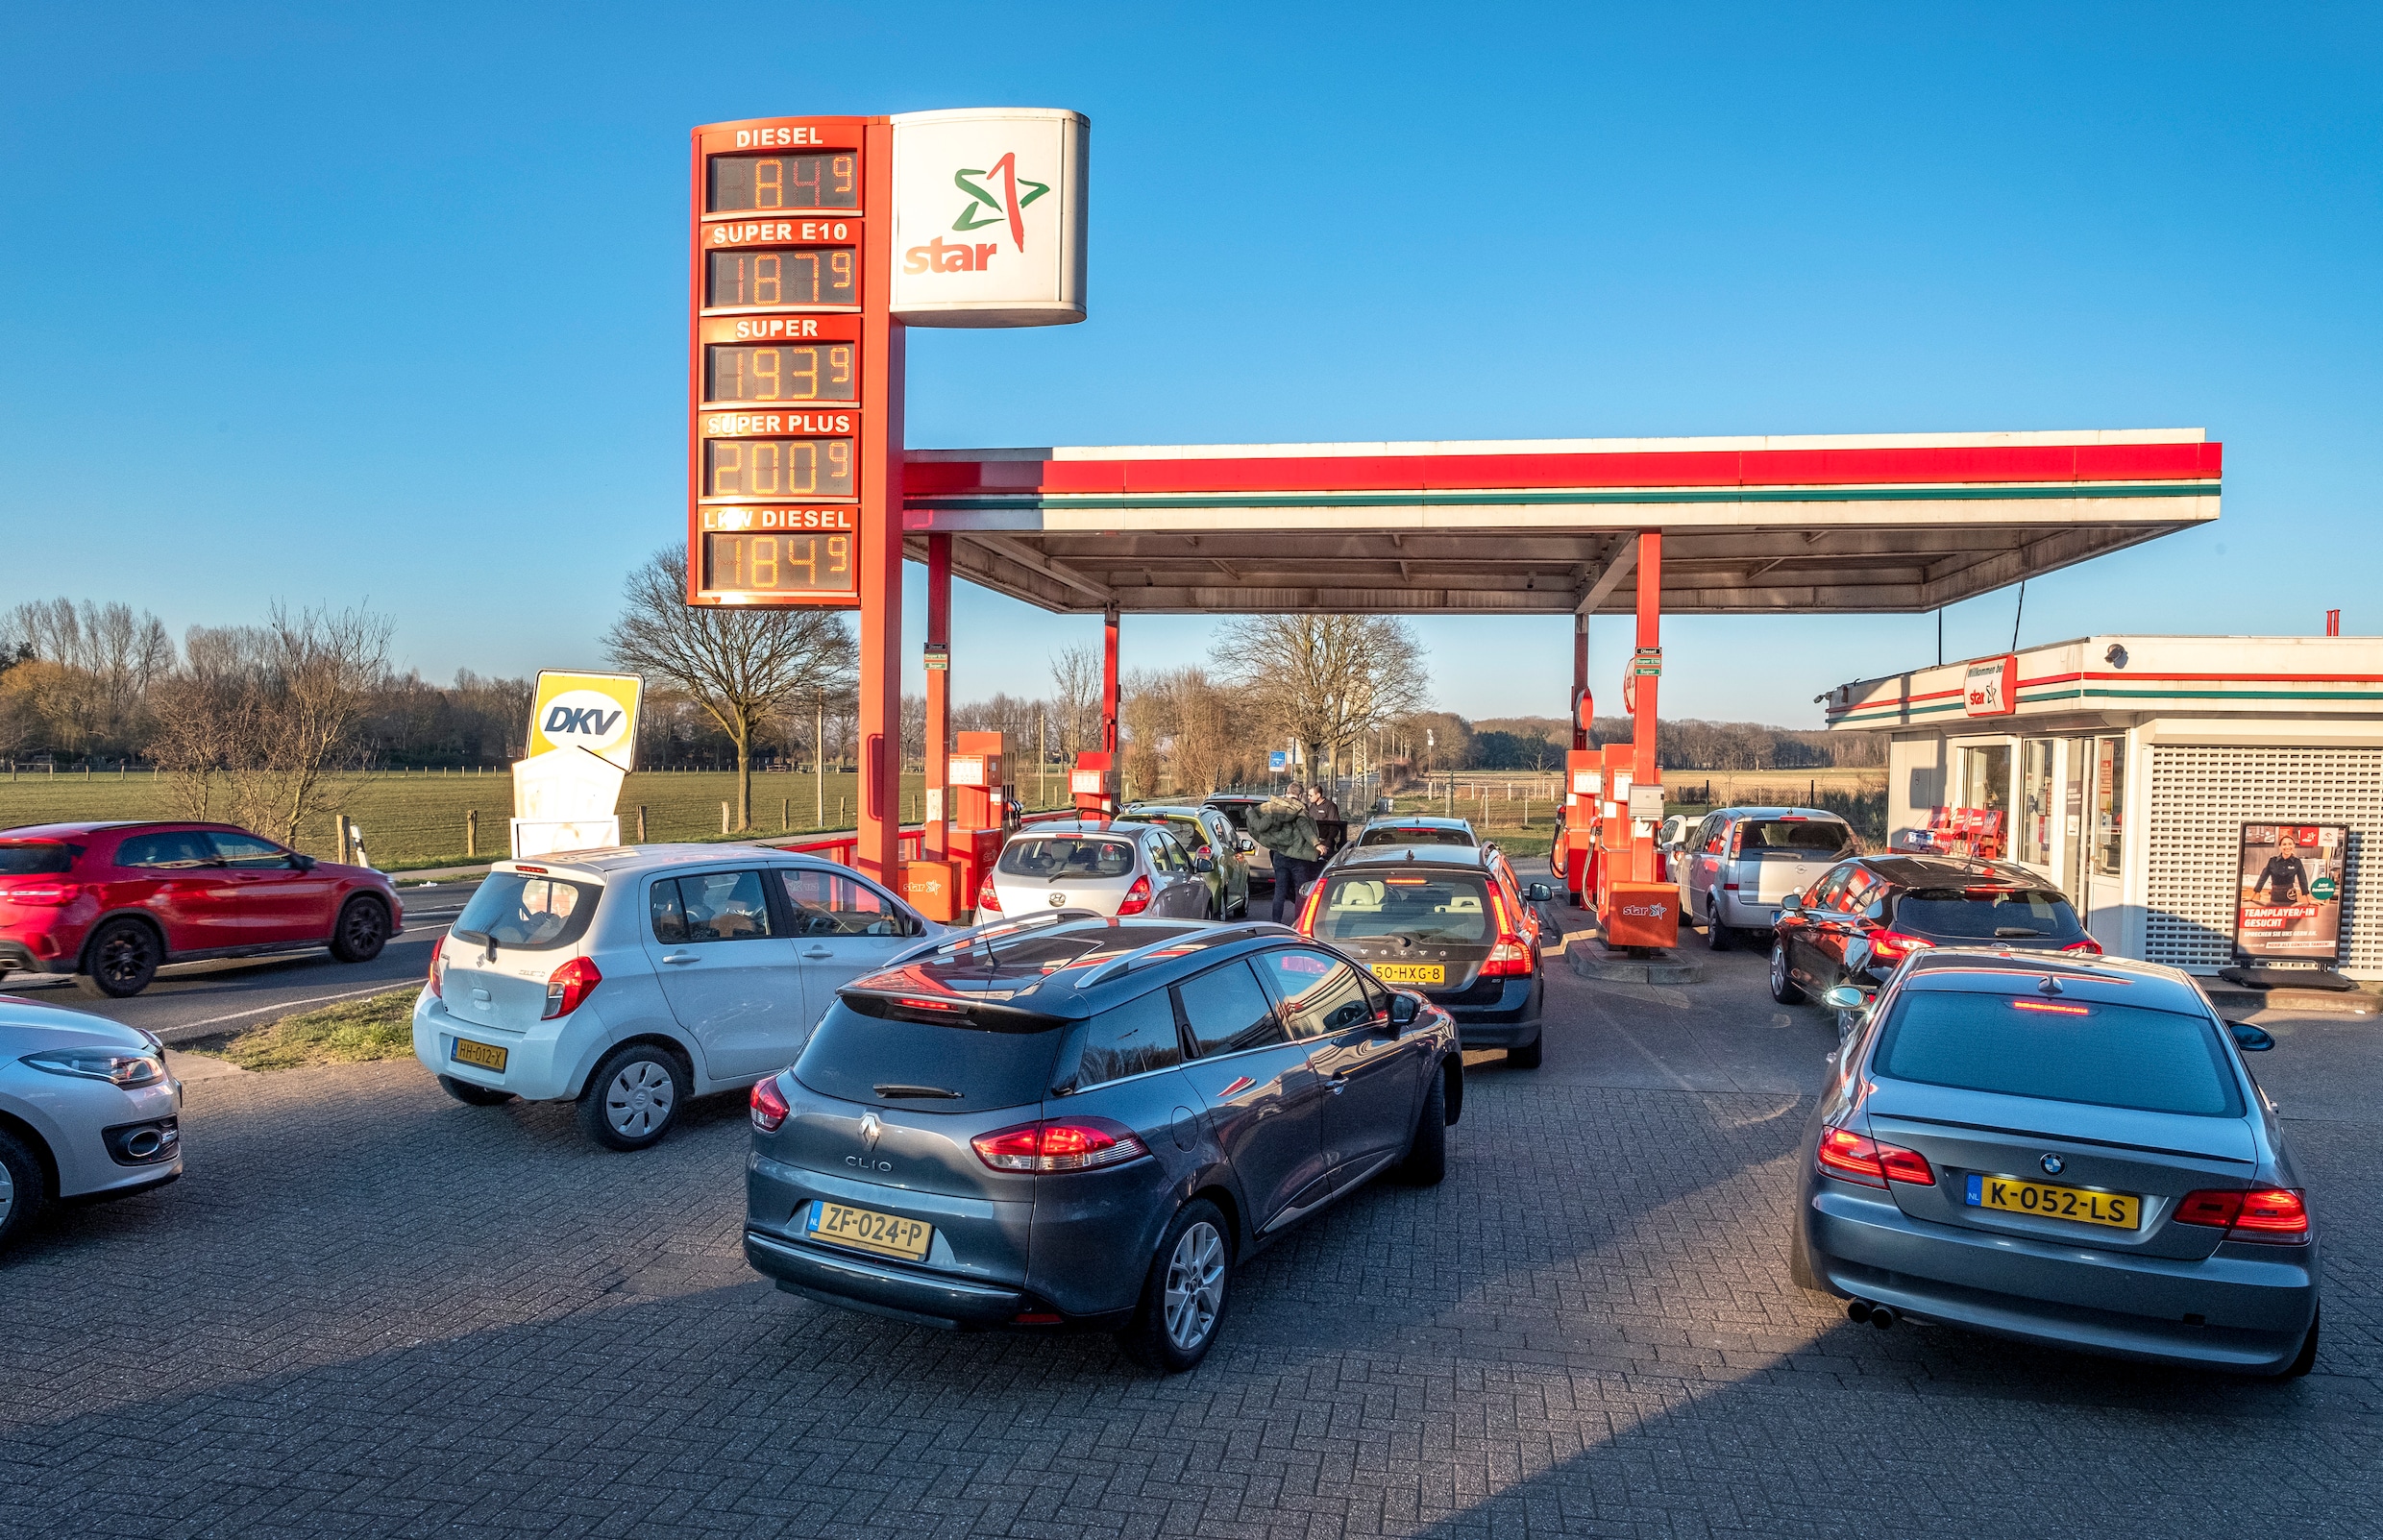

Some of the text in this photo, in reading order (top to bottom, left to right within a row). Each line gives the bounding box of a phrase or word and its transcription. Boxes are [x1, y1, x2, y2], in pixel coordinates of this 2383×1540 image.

[736, 127, 823, 148] DIESEL
[713, 222, 848, 244] SUPER E10
[903, 235, 997, 276] star
[736, 319, 818, 338] SUPER
[707, 415, 850, 435] SUPER PLUS
[762, 510, 851, 527] DIESEL
[1970, 688, 1985, 705] star
[544, 706, 623, 736] DKV
[903, 881, 925, 892] star
[1623, 904, 1649, 916] star
[2244, 908, 2316, 917] TEAMPLAYER/-IN
[2244, 918, 2283, 928] GESUCHT
[1360, 948, 1447, 957] VOLVO
[1375, 966, 1440, 980] 50-HXG-8
[459, 1042, 502, 1066] HH-012-X
[846, 1156, 893, 1172] CLIO
[1968, 1192, 1979, 1201] NL
[1990, 1182, 2125, 1223] K-052-LS
[809, 1217, 819, 1227] NL
[826, 1207, 922, 1247] ZF-024-P
